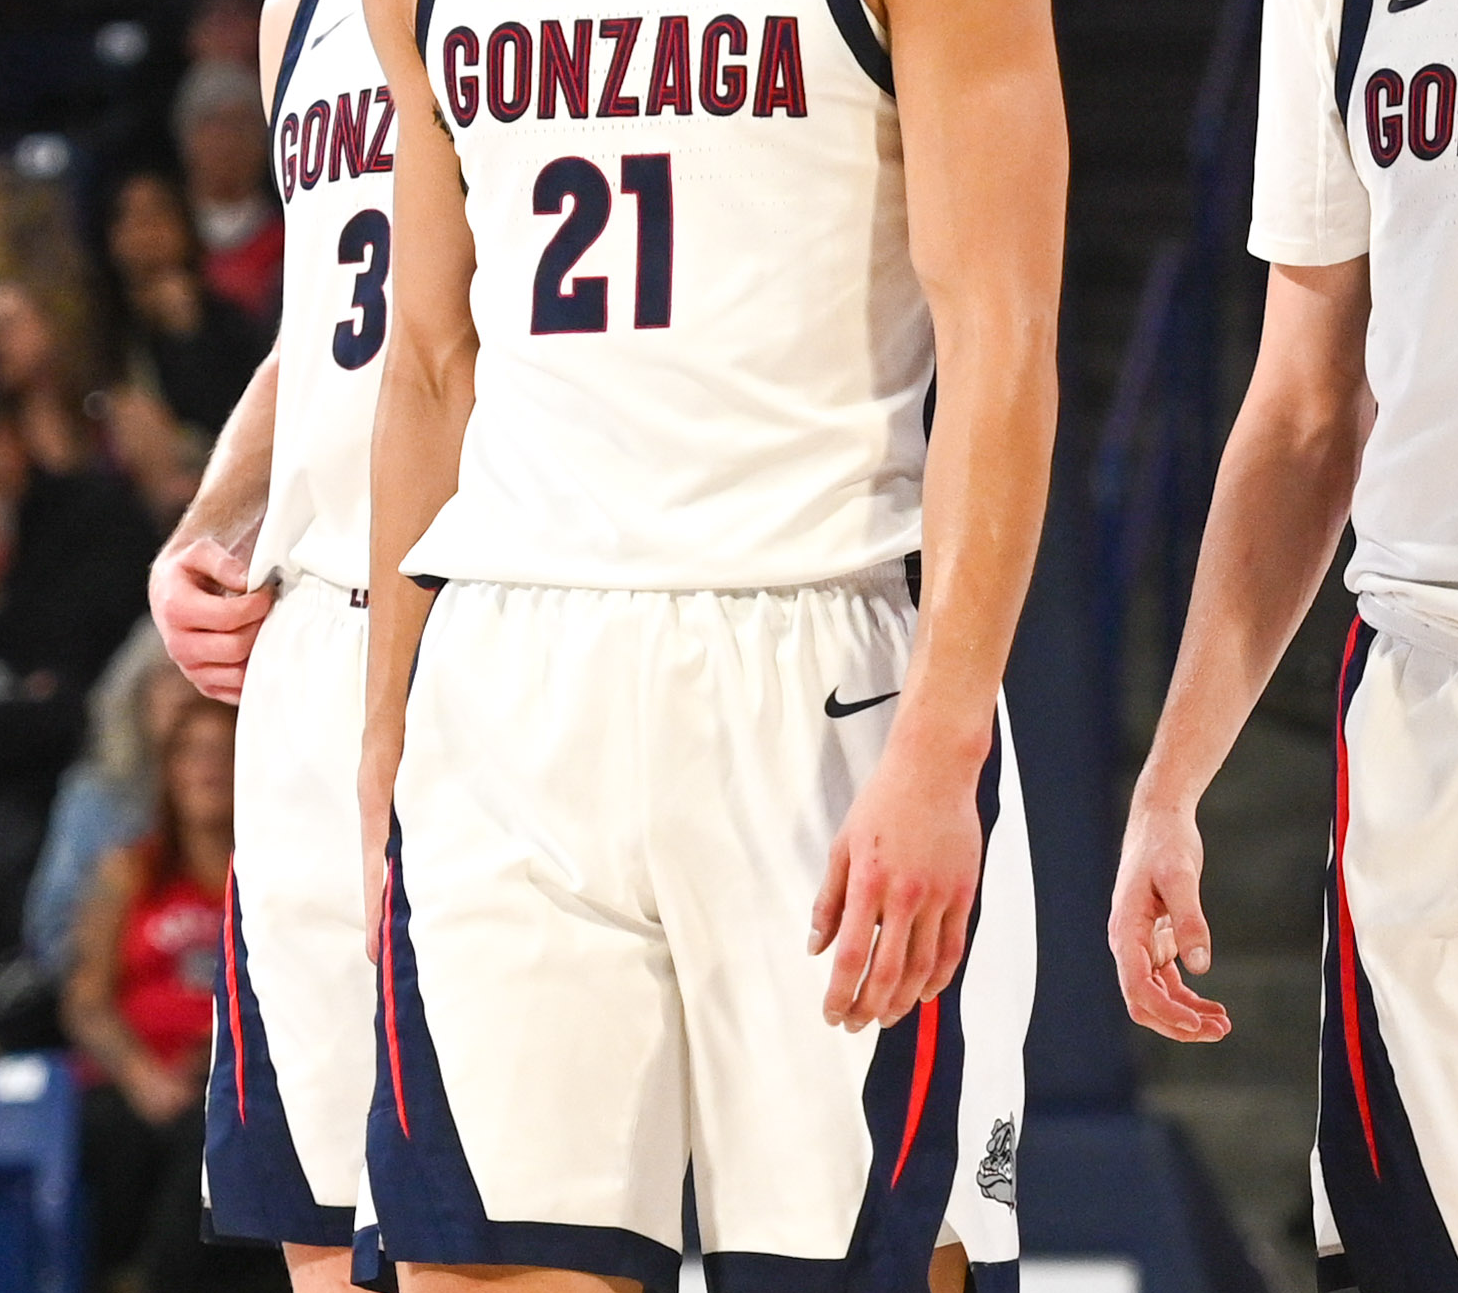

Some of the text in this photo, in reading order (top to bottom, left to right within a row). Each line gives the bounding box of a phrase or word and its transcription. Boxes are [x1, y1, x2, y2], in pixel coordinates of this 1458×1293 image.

[443, 13, 808, 128] GONZAGA
[332, 208, 391, 371] 3
[530, 152, 674, 336] 21
